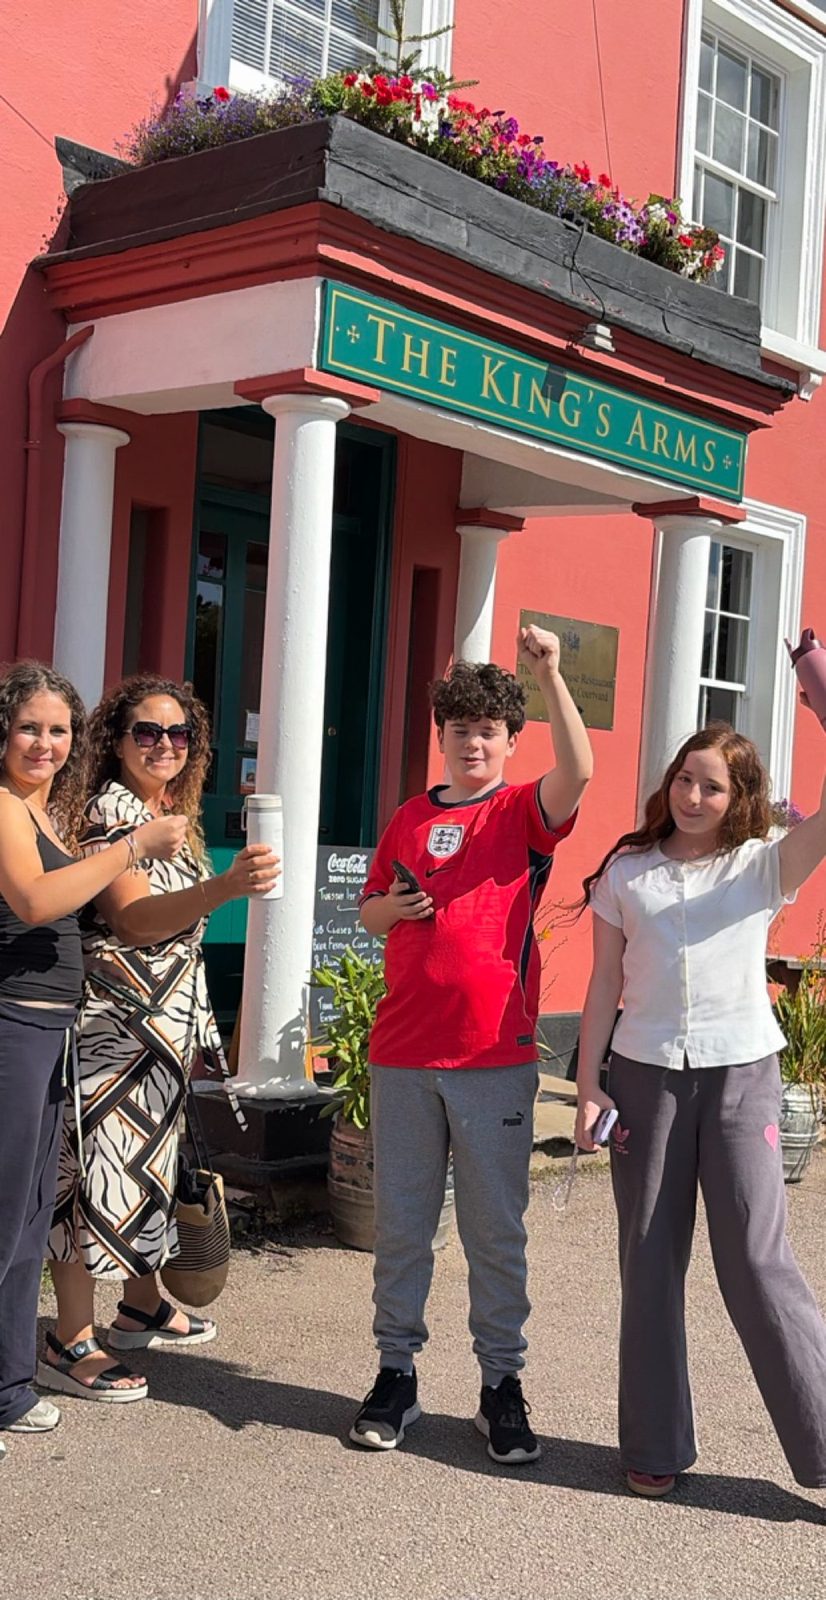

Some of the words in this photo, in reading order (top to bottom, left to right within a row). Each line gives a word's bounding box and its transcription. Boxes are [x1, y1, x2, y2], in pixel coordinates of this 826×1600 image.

[367, 313, 458, 387] THE
[480, 354, 612, 437] KING'S
[625, 410, 716, 473] ARMS
[502, 1117, 522, 1127] PUMA
